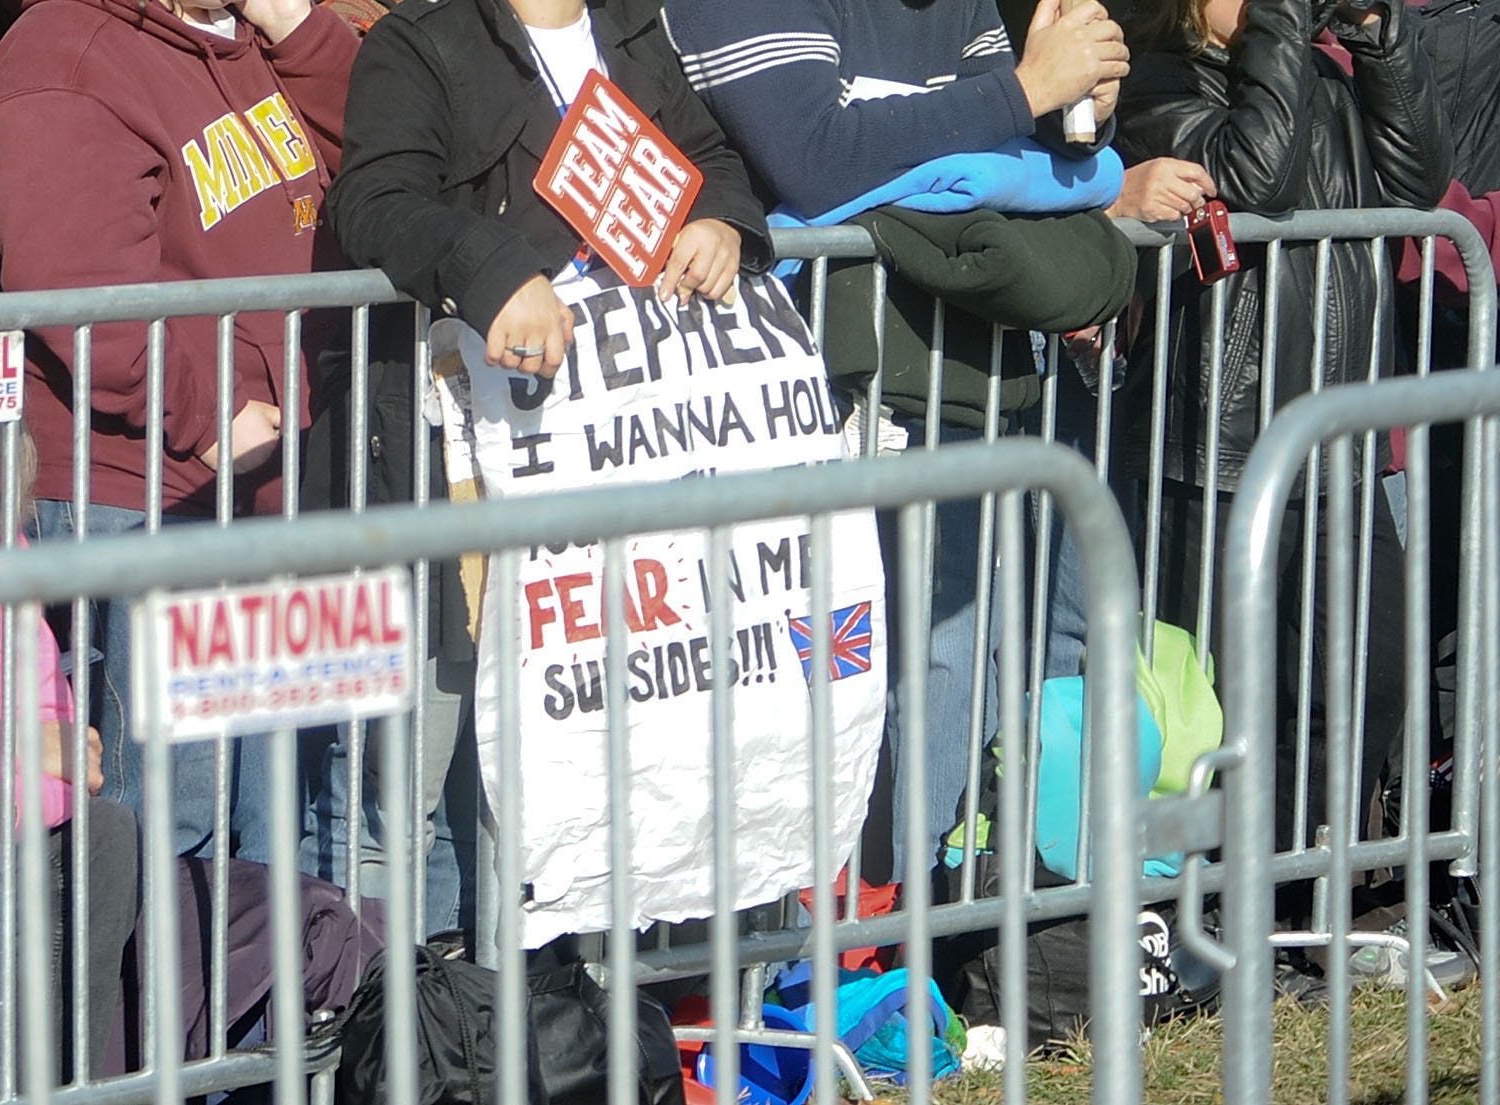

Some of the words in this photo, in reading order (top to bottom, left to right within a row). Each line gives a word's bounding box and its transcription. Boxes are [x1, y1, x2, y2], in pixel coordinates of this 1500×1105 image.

[548, 83, 640, 223] TEAM
[593, 135, 691, 282] FEAR
[512, 433, 554, 478] I
[584, 392, 756, 471] WANNA
[168, 581, 402, 670] NATIONAL
